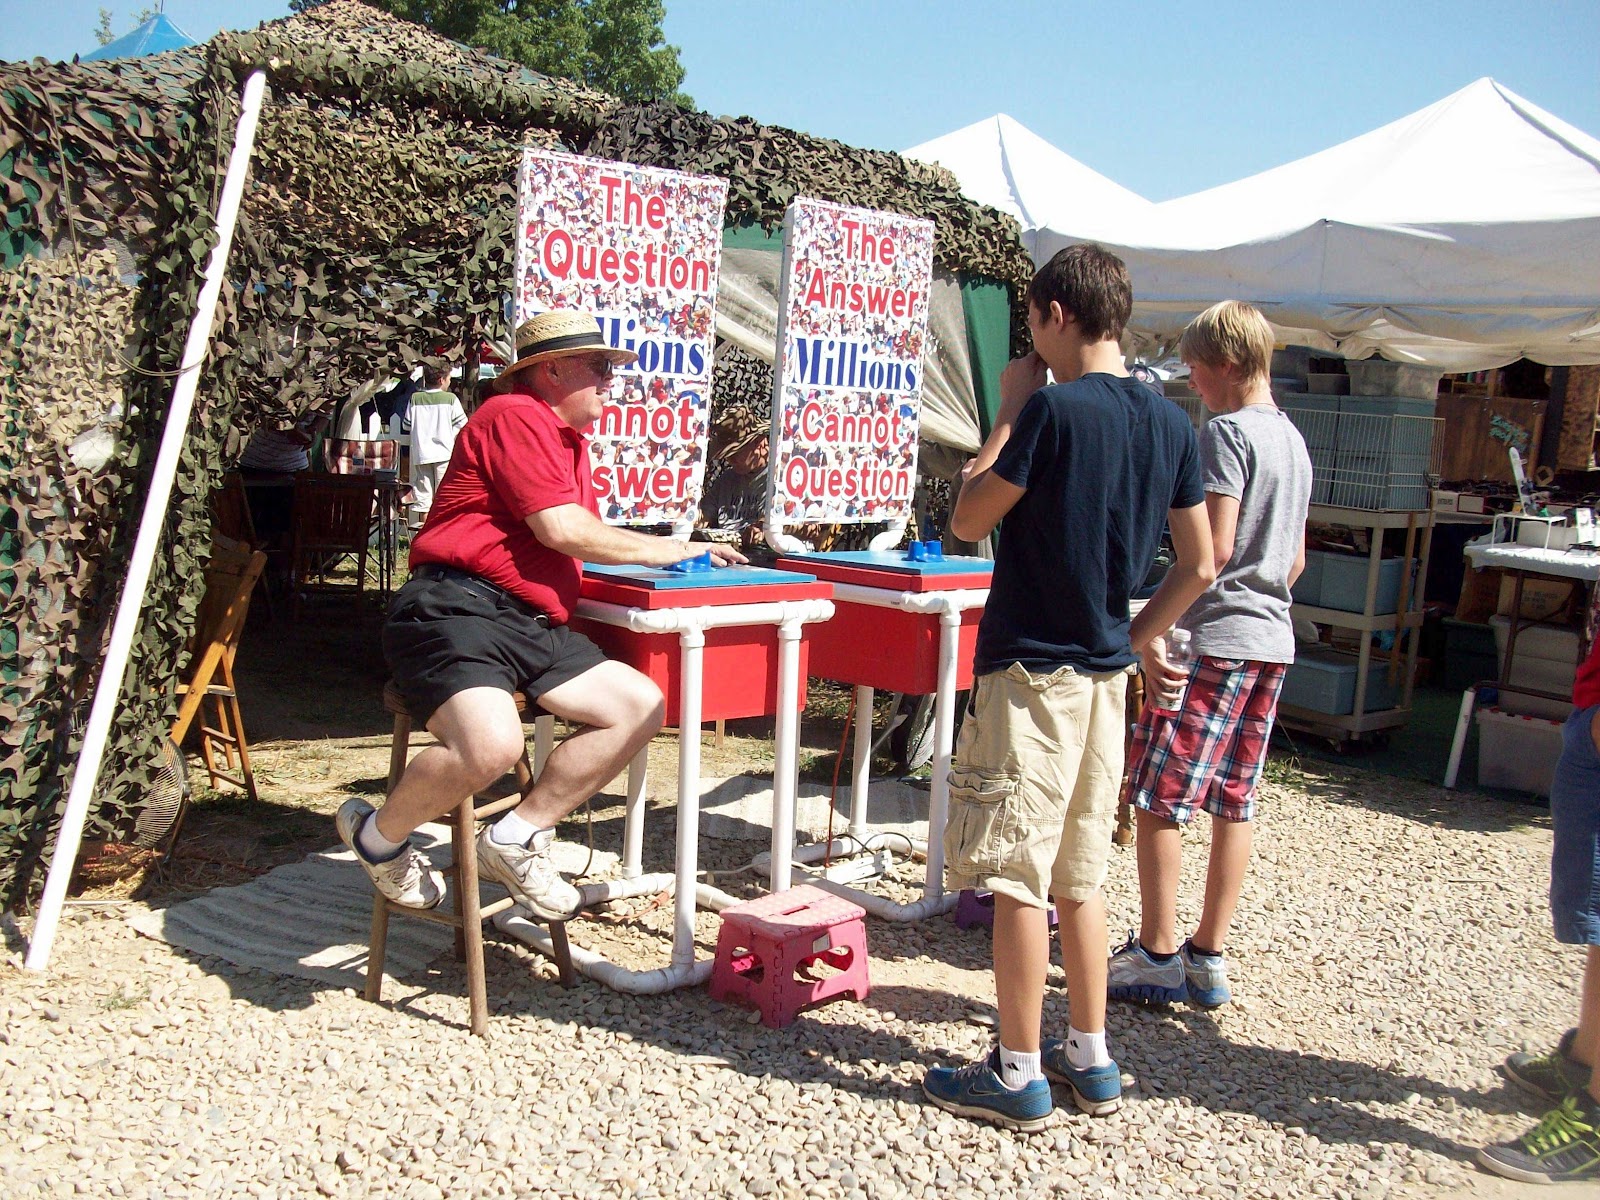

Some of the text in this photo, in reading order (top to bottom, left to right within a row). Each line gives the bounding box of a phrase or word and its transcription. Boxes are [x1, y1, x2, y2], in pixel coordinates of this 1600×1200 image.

[600, 176, 667, 230] The
[543, 229, 710, 292] Question
[842, 220, 895, 266] The
[805, 268, 919, 318] Answer
[791, 337, 917, 391] Millions
[581, 399, 694, 440] nnot
[802, 403, 902, 444] Cannot
[592, 465, 692, 499] swer
[785, 457, 909, 498] Question
